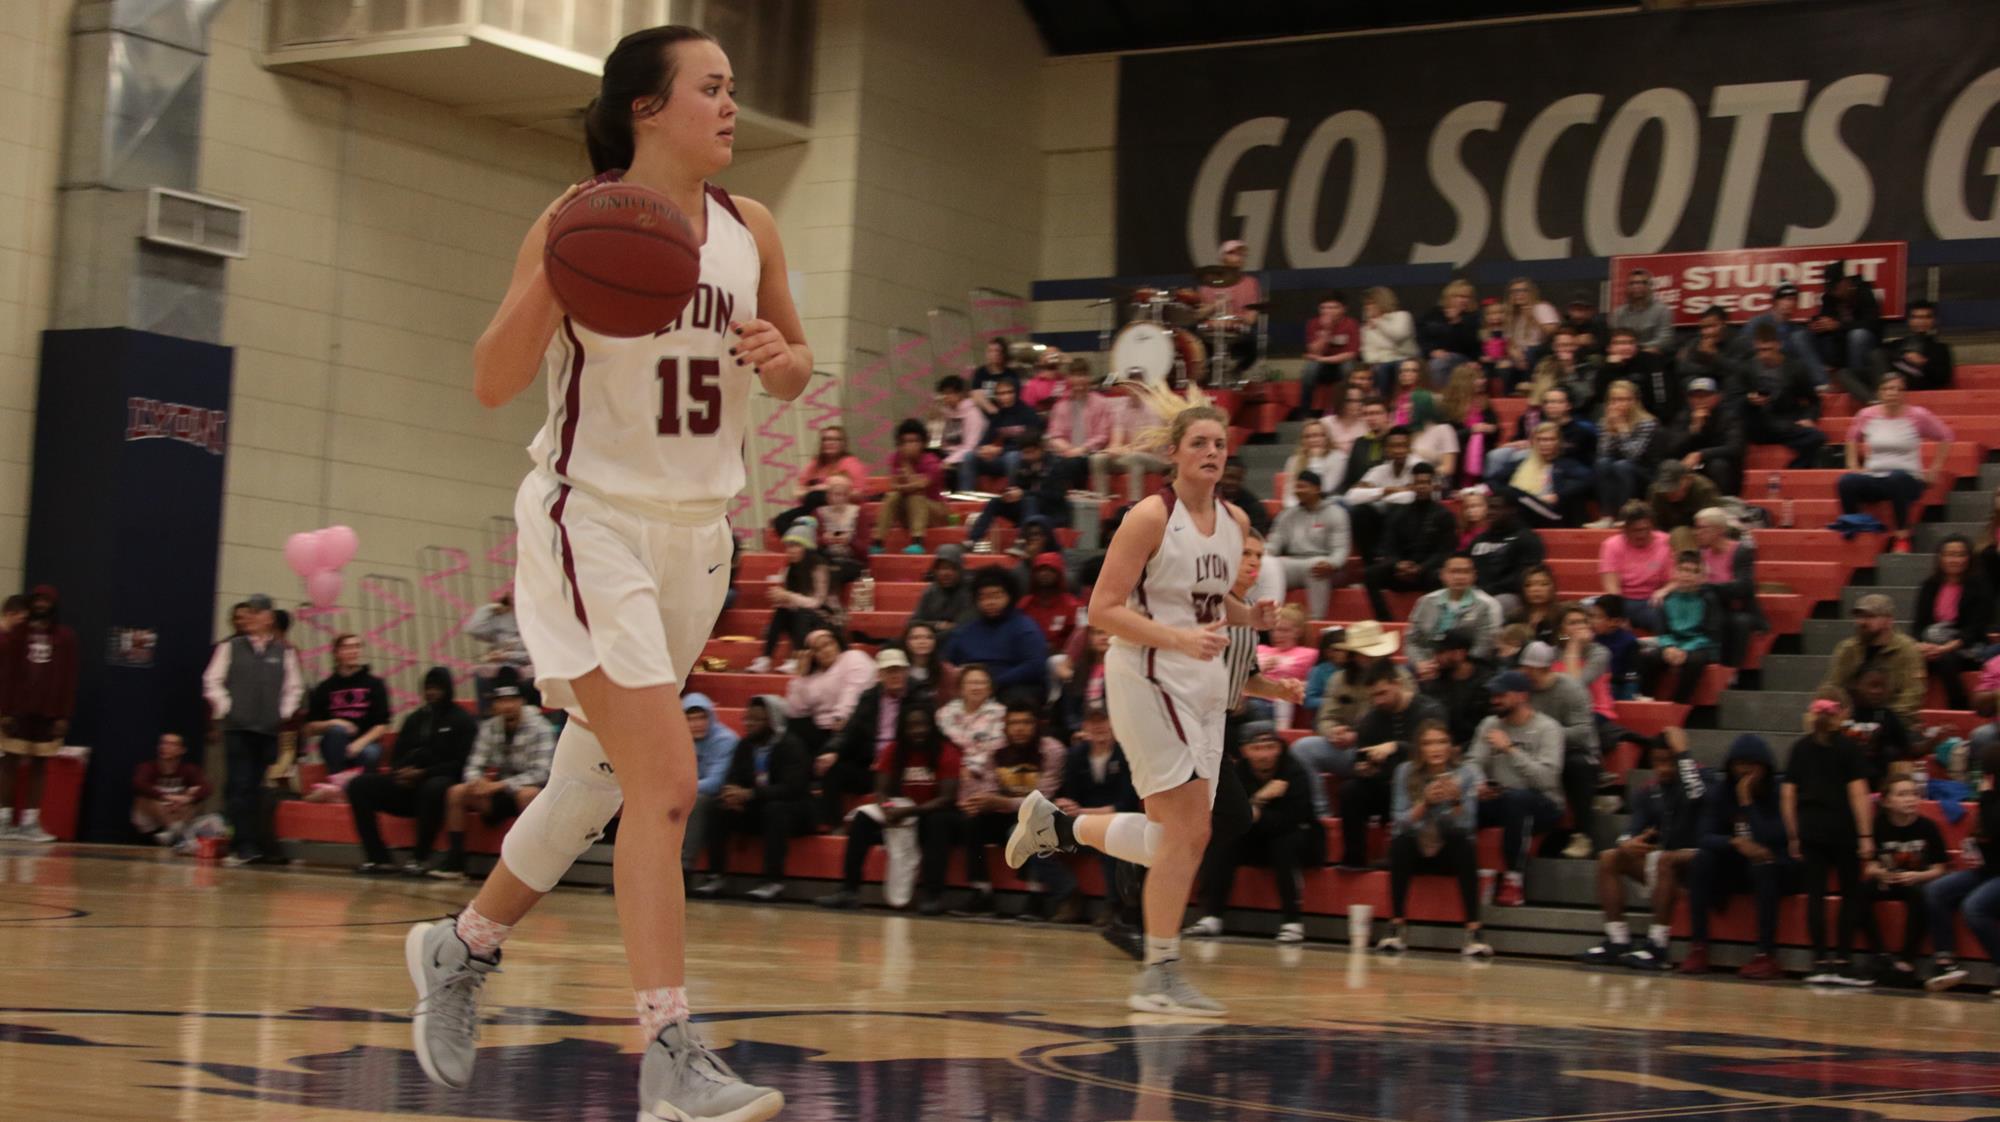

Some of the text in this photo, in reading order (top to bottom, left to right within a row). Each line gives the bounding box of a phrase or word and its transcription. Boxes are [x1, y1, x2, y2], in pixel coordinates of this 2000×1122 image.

[1186, 109, 1387, 272] GO
[1408, 74, 1892, 268] SCOTS
[654, 282, 735, 340] ON
[126, 396, 226, 456] LYON
[655, 356, 722, 437] 15
